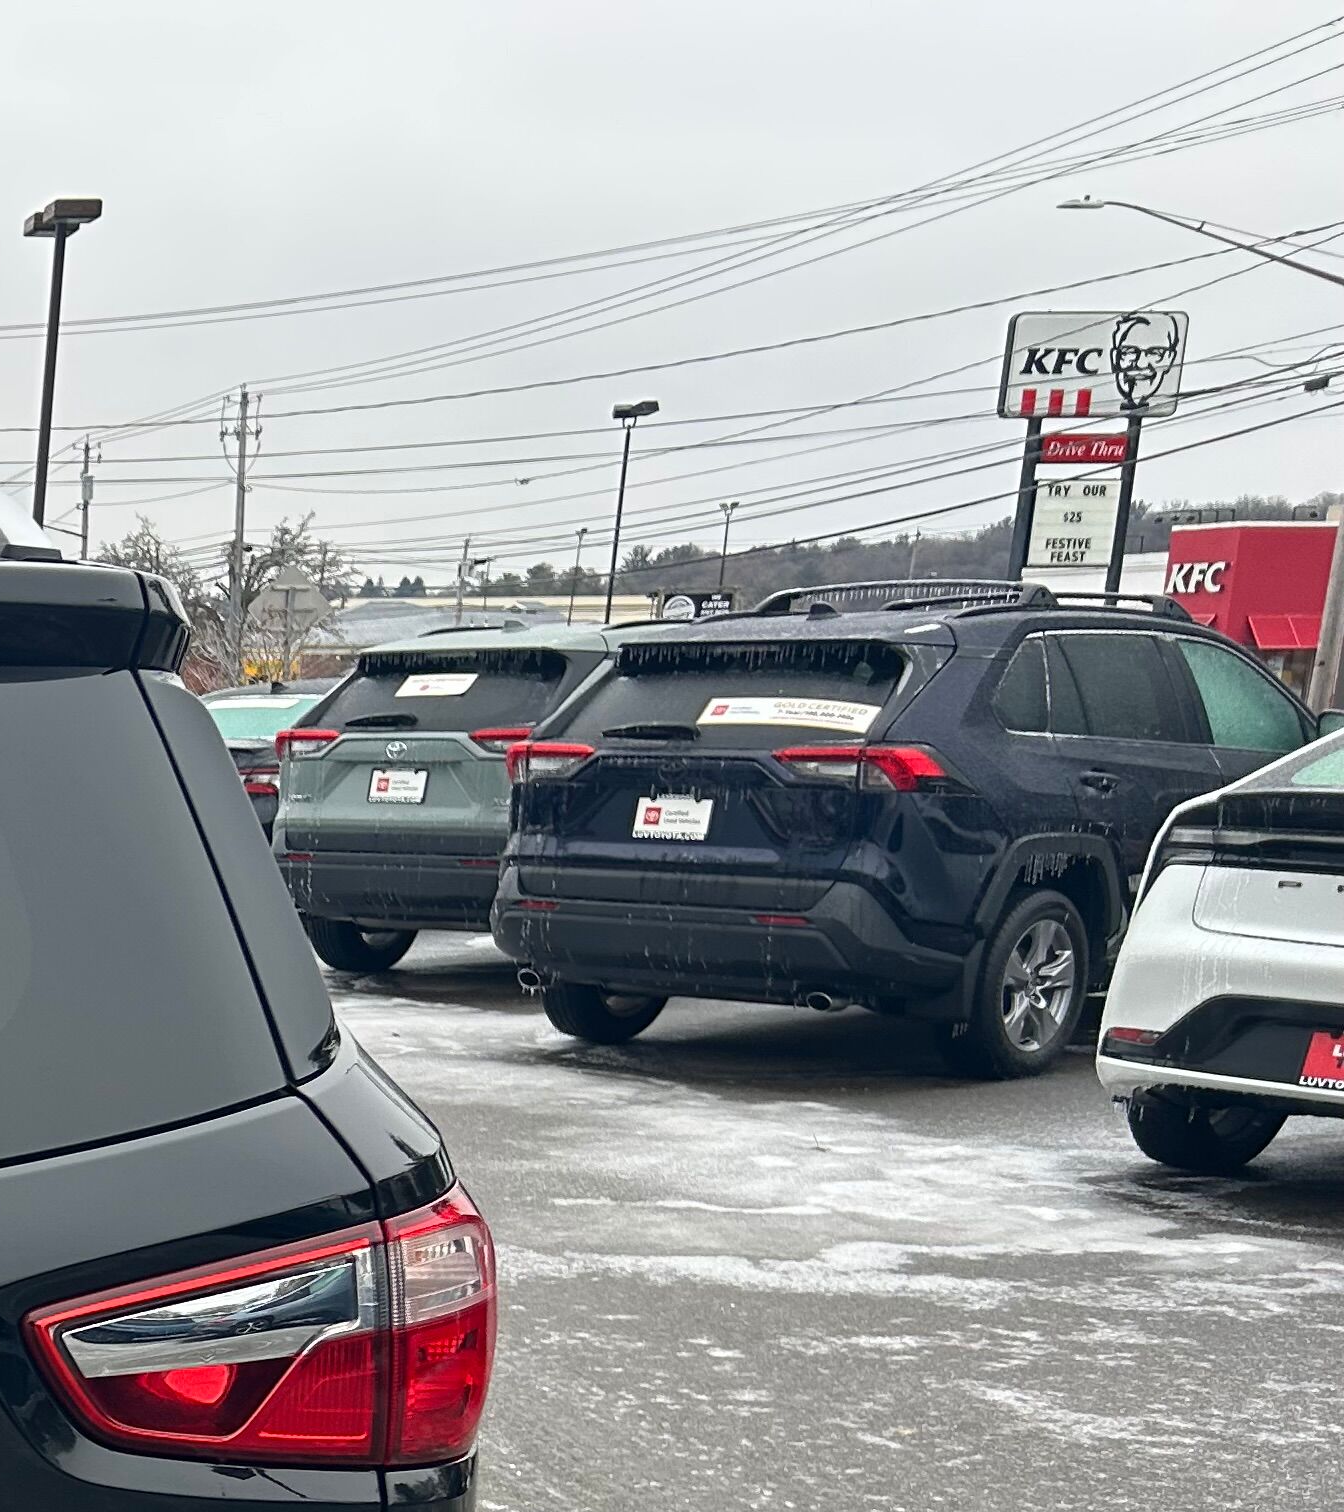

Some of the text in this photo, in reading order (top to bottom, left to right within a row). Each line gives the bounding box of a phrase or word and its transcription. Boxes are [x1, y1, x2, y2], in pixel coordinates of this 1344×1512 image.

[1019, 347, 1103, 375] KFC
[1047, 440, 1124, 457] Drive Thru
[1048, 485, 1107, 497] TRY OUR
[1063, 511, 1082, 523] $25
[1045, 537, 1092, 550] FESTIVE
[1050, 551, 1086, 563] FEAST
[1164, 561, 1226, 594] KFC
[773, 701, 806, 710] GOLD
[808, 703, 869, 716] CERTIFIED
